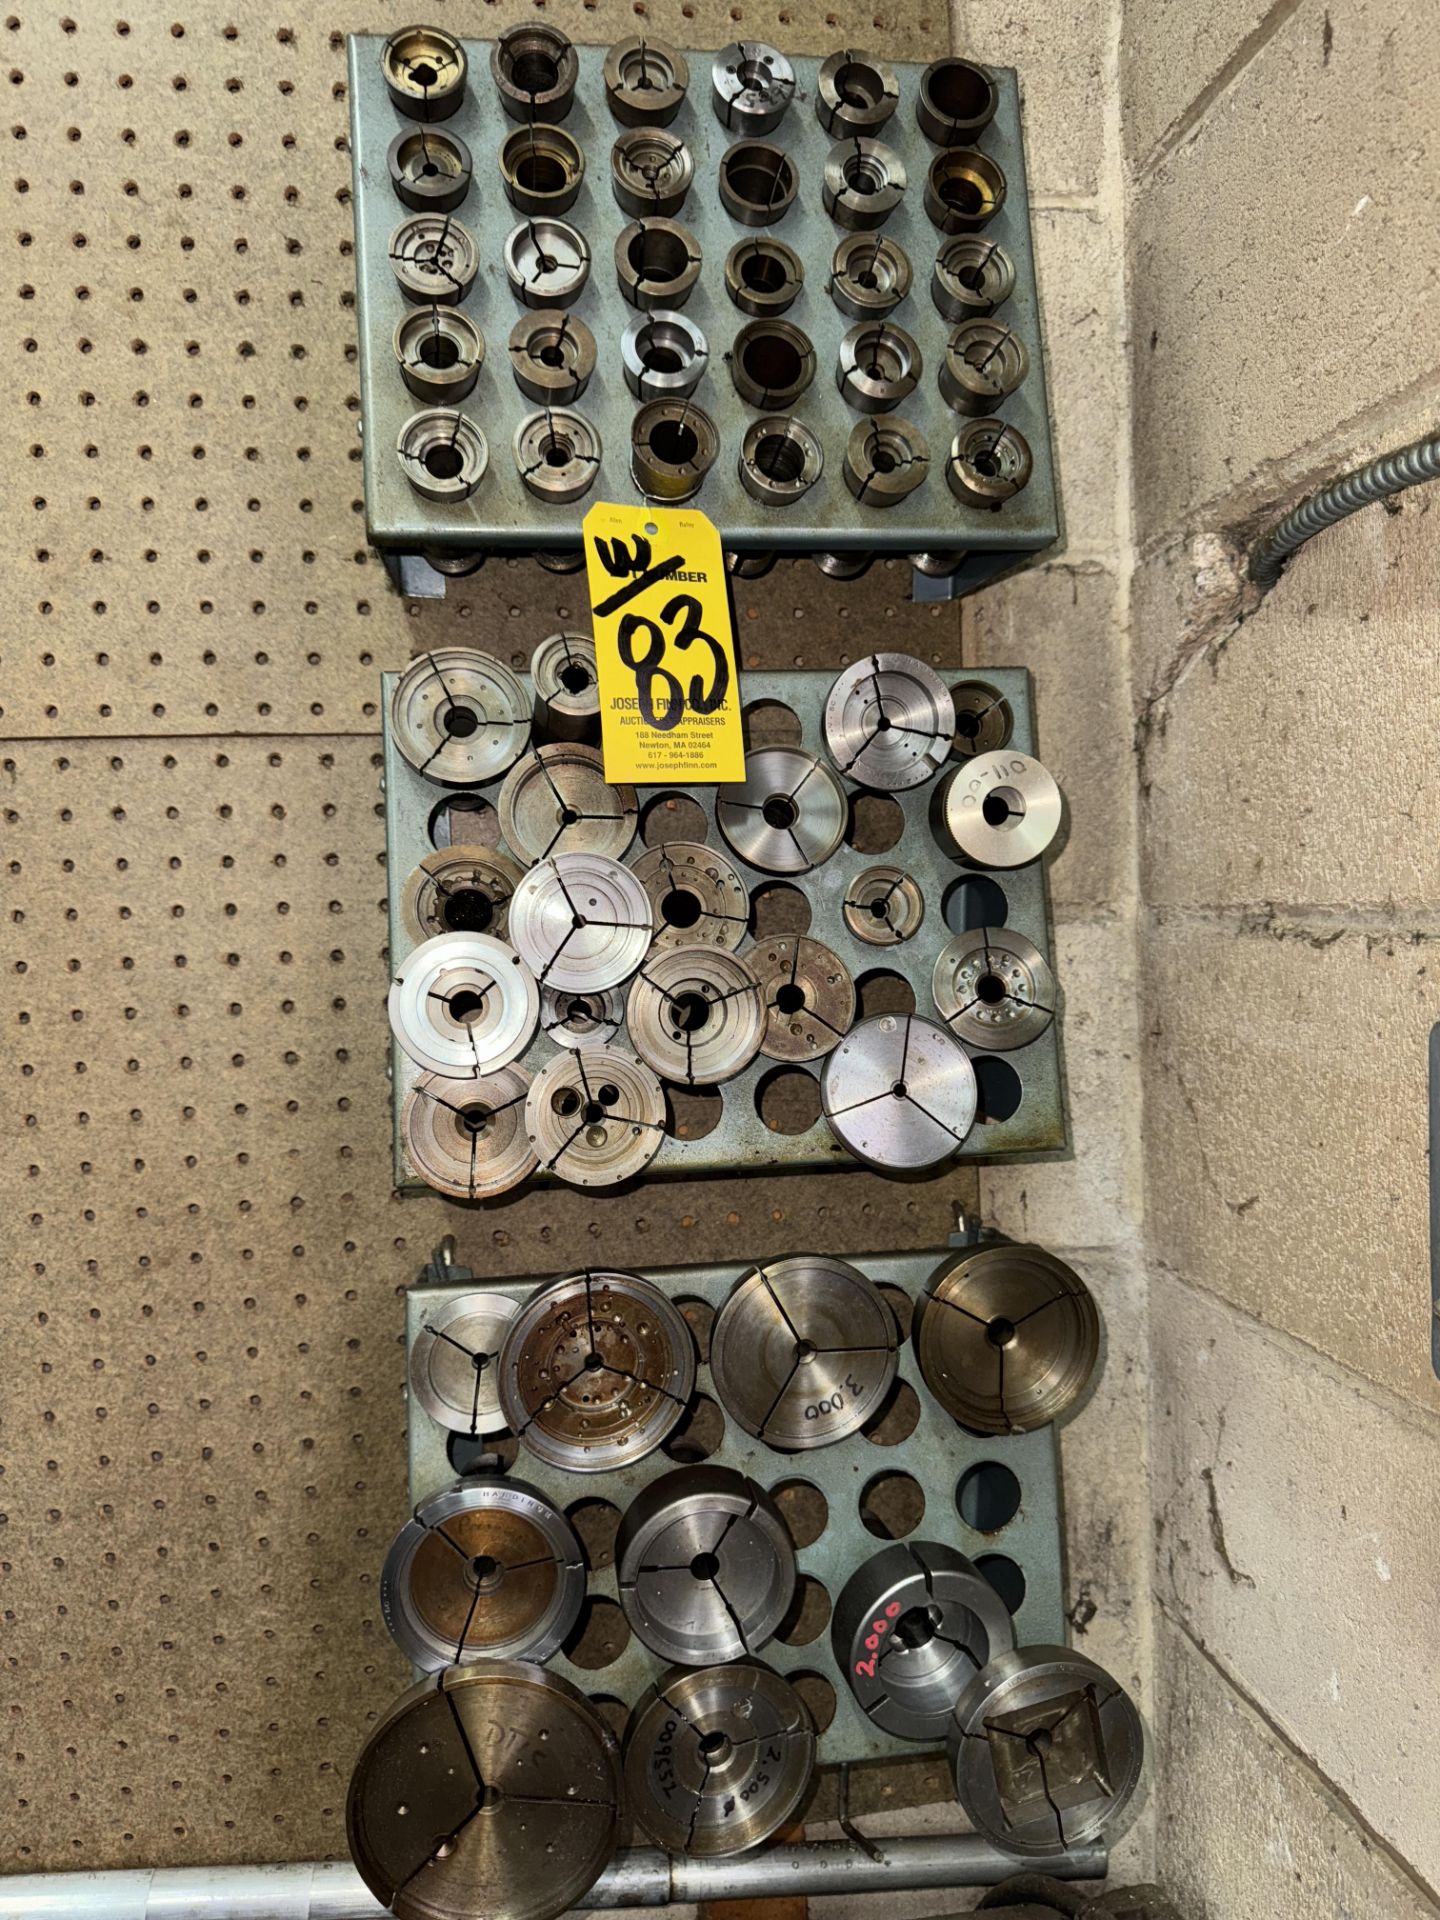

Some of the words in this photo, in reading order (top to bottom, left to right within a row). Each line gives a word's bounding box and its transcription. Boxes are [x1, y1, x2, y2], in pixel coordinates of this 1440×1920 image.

[617, 594, 729, 731] 83
[639, 742, 671, 750] Newton,
[651, 731, 688, 739] Needham
[690, 731, 713, 739] Street
[635, 761, 717, 771] www.josephfinn.com
[804, 1373, 864, 1420] 3.000
[855, 1601, 901, 1677] 2.000
